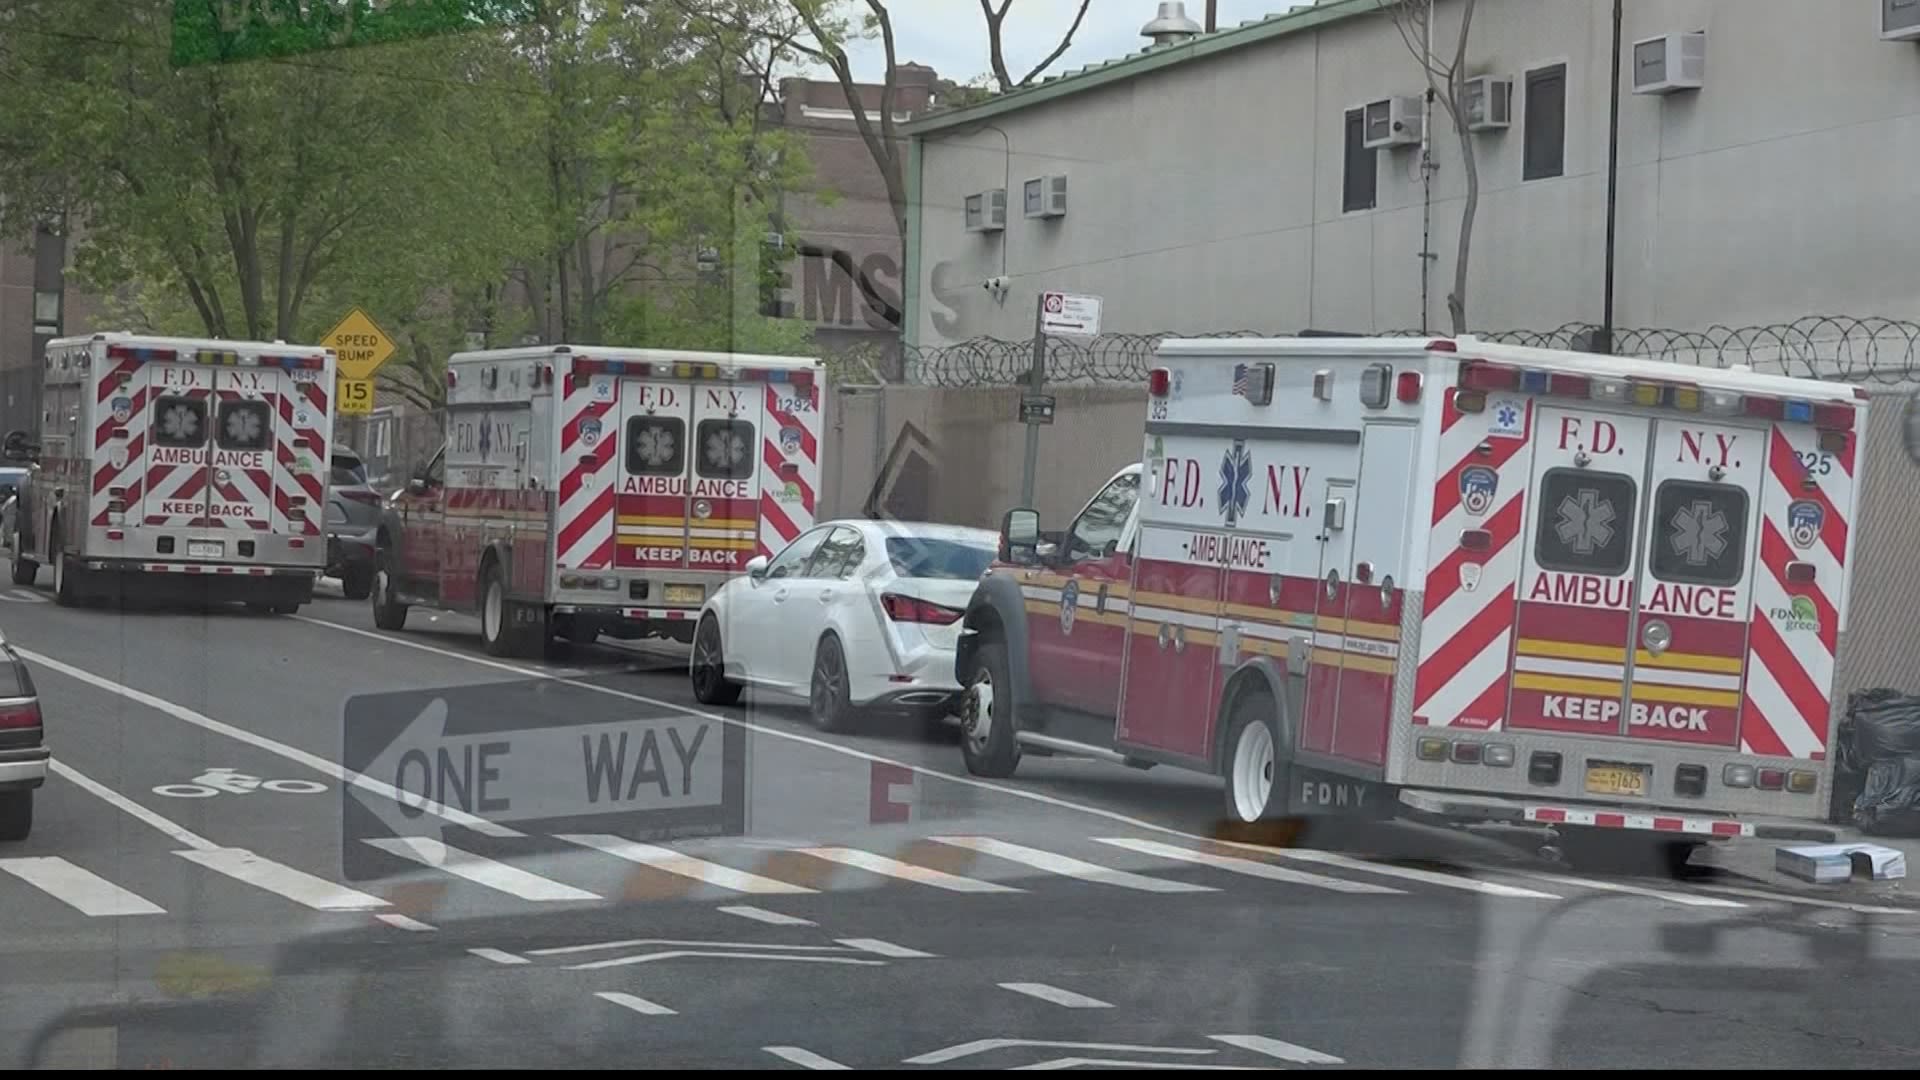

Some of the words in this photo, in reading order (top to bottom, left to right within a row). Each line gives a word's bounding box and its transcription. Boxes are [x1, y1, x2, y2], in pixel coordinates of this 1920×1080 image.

[336, 334, 378, 347] SPEED
[338, 350, 375, 361] BUMP
[162, 366, 200, 387] F.D.
[228, 371, 265, 390] N.Y.
[344, 382, 367, 400] 15
[639, 386, 680, 407] F.D.
[705, 389, 746, 411] N.Y.
[776, 397, 812, 413] 1292
[1557, 416, 1624, 455] F.D.
[1677, 429, 1741, 468] N.Y.
[151, 447, 264, 468] AMBULANCE
[624, 475, 749, 499] AMBULANCE
[1161, 458, 1204, 508] F.D.
[1262, 464, 1312, 518] N.Y.
[162, 501, 204, 516] KEEP
[209, 503, 255, 517] BACK
[635, 546, 682, 562] KEEP
[687, 549, 737, 564] BACK
[1188, 534, 1266, 568] AMBULANCE
[1530, 573, 1737, 618] AMBULANCE
[1769, 606, 1804, 621] FDNY
[1784, 614, 1821, 633] green
[1542, 695, 1620, 724] KEEP
[1628, 700, 1709, 733] BACK
[395, 742, 512, 819] ONE
[582, 724, 710, 804] WAY
[1302, 781, 1368, 807] FDNY
